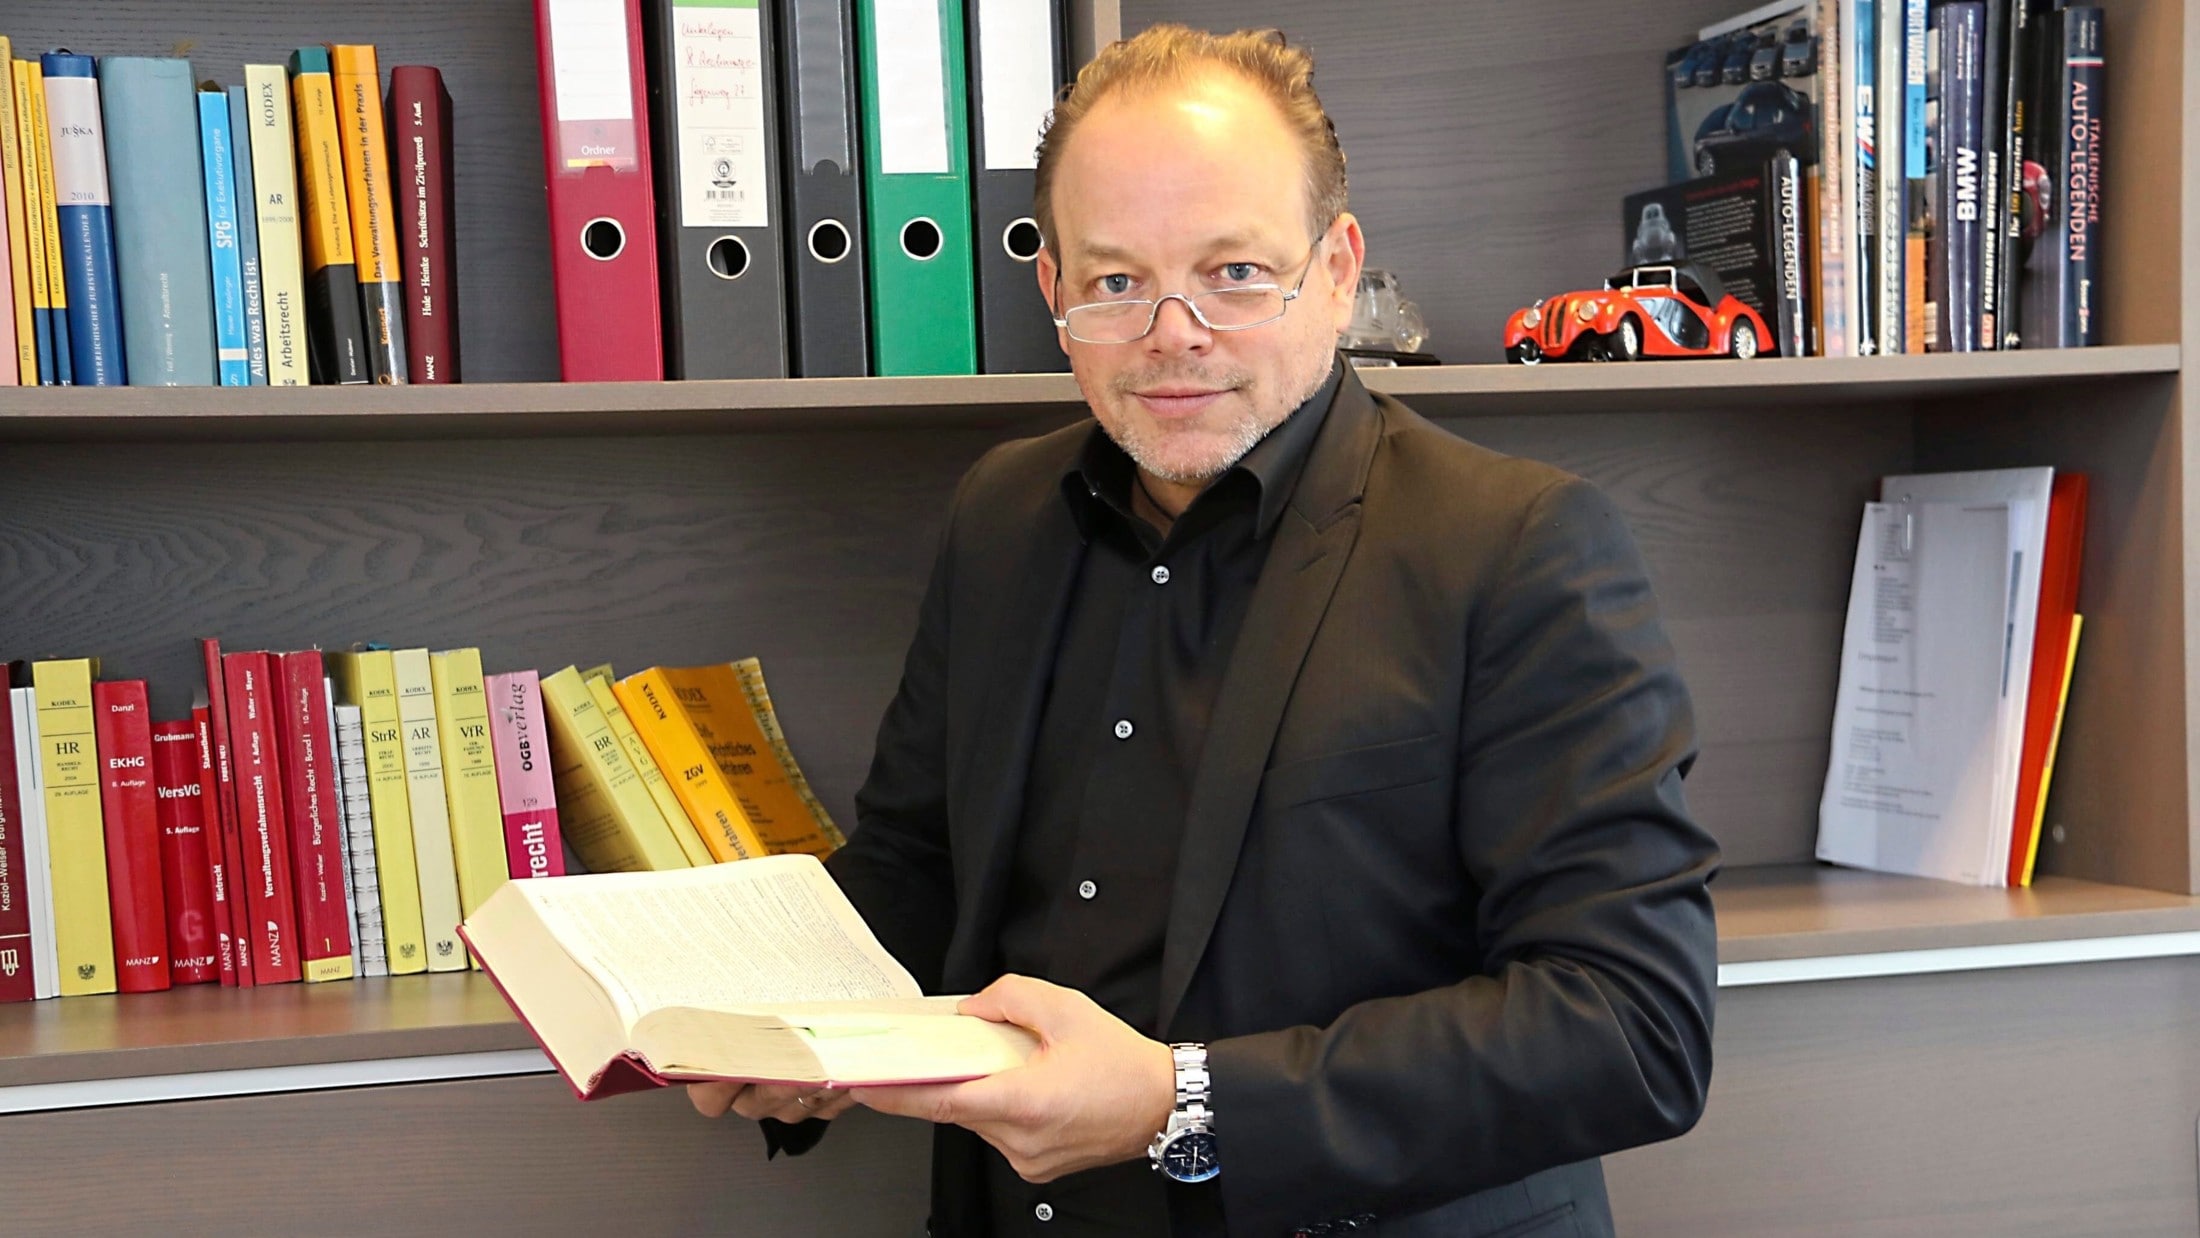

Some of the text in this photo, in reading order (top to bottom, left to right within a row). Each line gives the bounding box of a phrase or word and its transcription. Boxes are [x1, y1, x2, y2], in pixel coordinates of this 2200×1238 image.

[262, 82, 275, 127] KODEX
[1827, 94, 1836, 121] EINES
[581, 145, 616, 156] Ordner
[1828, 122, 1837, 182] GESCHICHTE
[212, 128, 226, 203] Exekutivorgane
[2008, 100, 2024, 238] Die 100 teuersten Autos
[2069, 81, 2089, 261] AUTO-LEGENDEN
[2087, 118, 2101, 223] ITALIENISCHE
[353, 83, 383, 278] Das Verwaltungsverfahren in der Praxis
[1829, 183, 1837, 200] DIE
[1956, 147, 1977, 221] BMW
[1986, 151, 1998, 229] MOTORSPORT
[71, 191, 95, 201] 2010
[269, 193, 283, 205] AR
[414, 136, 432, 316] Hule Heinke Schriftsätze im Zivilprozeß
[1885, 178, 1898, 263] PORSCHE
[214, 221, 233, 248] SPG
[1780, 176, 1798, 299] AUTO-LEGENDEN
[81, 213, 96, 301] JURISTENKALENDER
[244, 257, 256, 276] ist.
[1984, 232, 1995, 310] FASZINATION
[246, 280, 259, 315] Recht
[250, 319, 260, 344] was
[277, 291, 293, 368] Arbeitsrecht
[251, 347, 264, 377] Alles
[424, 355, 434, 380] MANZ
[244, 670, 257, 719] Walter Mayer
[300, 687, 309, 713] Auflage
[405, 686, 426, 694] KODEX
[456, 685, 478, 693] KODEX
[641, 682, 667, 720] KODEX
[51, 699, 77, 707] KODEX
[111, 703, 135, 712] Danzl
[573, 700, 592, 713] KODEX
[154, 732, 195, 742] Grubmann
[250, 731, 260, 756] Auflage
[371, 728, 398, 743] StrR
[411, 726, 431, 741] AR
[460, 724, 485, 739] VfR
[593, 735, 613, 752] BR
[56, 741, 81, 755] HR
[199, 721, 211, 769] Stabentheiner
[219, 744, 227, 760] NEU
[303, 739, 313, 762] Band
[109, 756, 145, 769] EKHG
[683, 763, 705, 781] ZGV
[64, 789, 88, 797] AUFLAGE
[120, 779, 146, 788] Auflage
[158, 783, 201, 798] VersVG
[307, 769, 317, 792] Recht
[175, 826, 200, 834] Auflage
[309, 793, 323, 846] Bürgerliches
[253, 775, 276, 898] Verwaltungsverfahrensrecht
[316, 854, 325, 876] Welser
[213, 864, 225, 902] Mietrecht
[179, 909, 205, 942] G
[220, 942, 232, 971] MANZ
[238, 944, 248, 967] MANZ
[268, 931, 282, 967] MANZ
[324, 937, 331, 953] 1
[126, 957, 151, 967] MANZ
[174, 956, 206, 968] MANZ
[320, 966, 341, 975] MANZ
